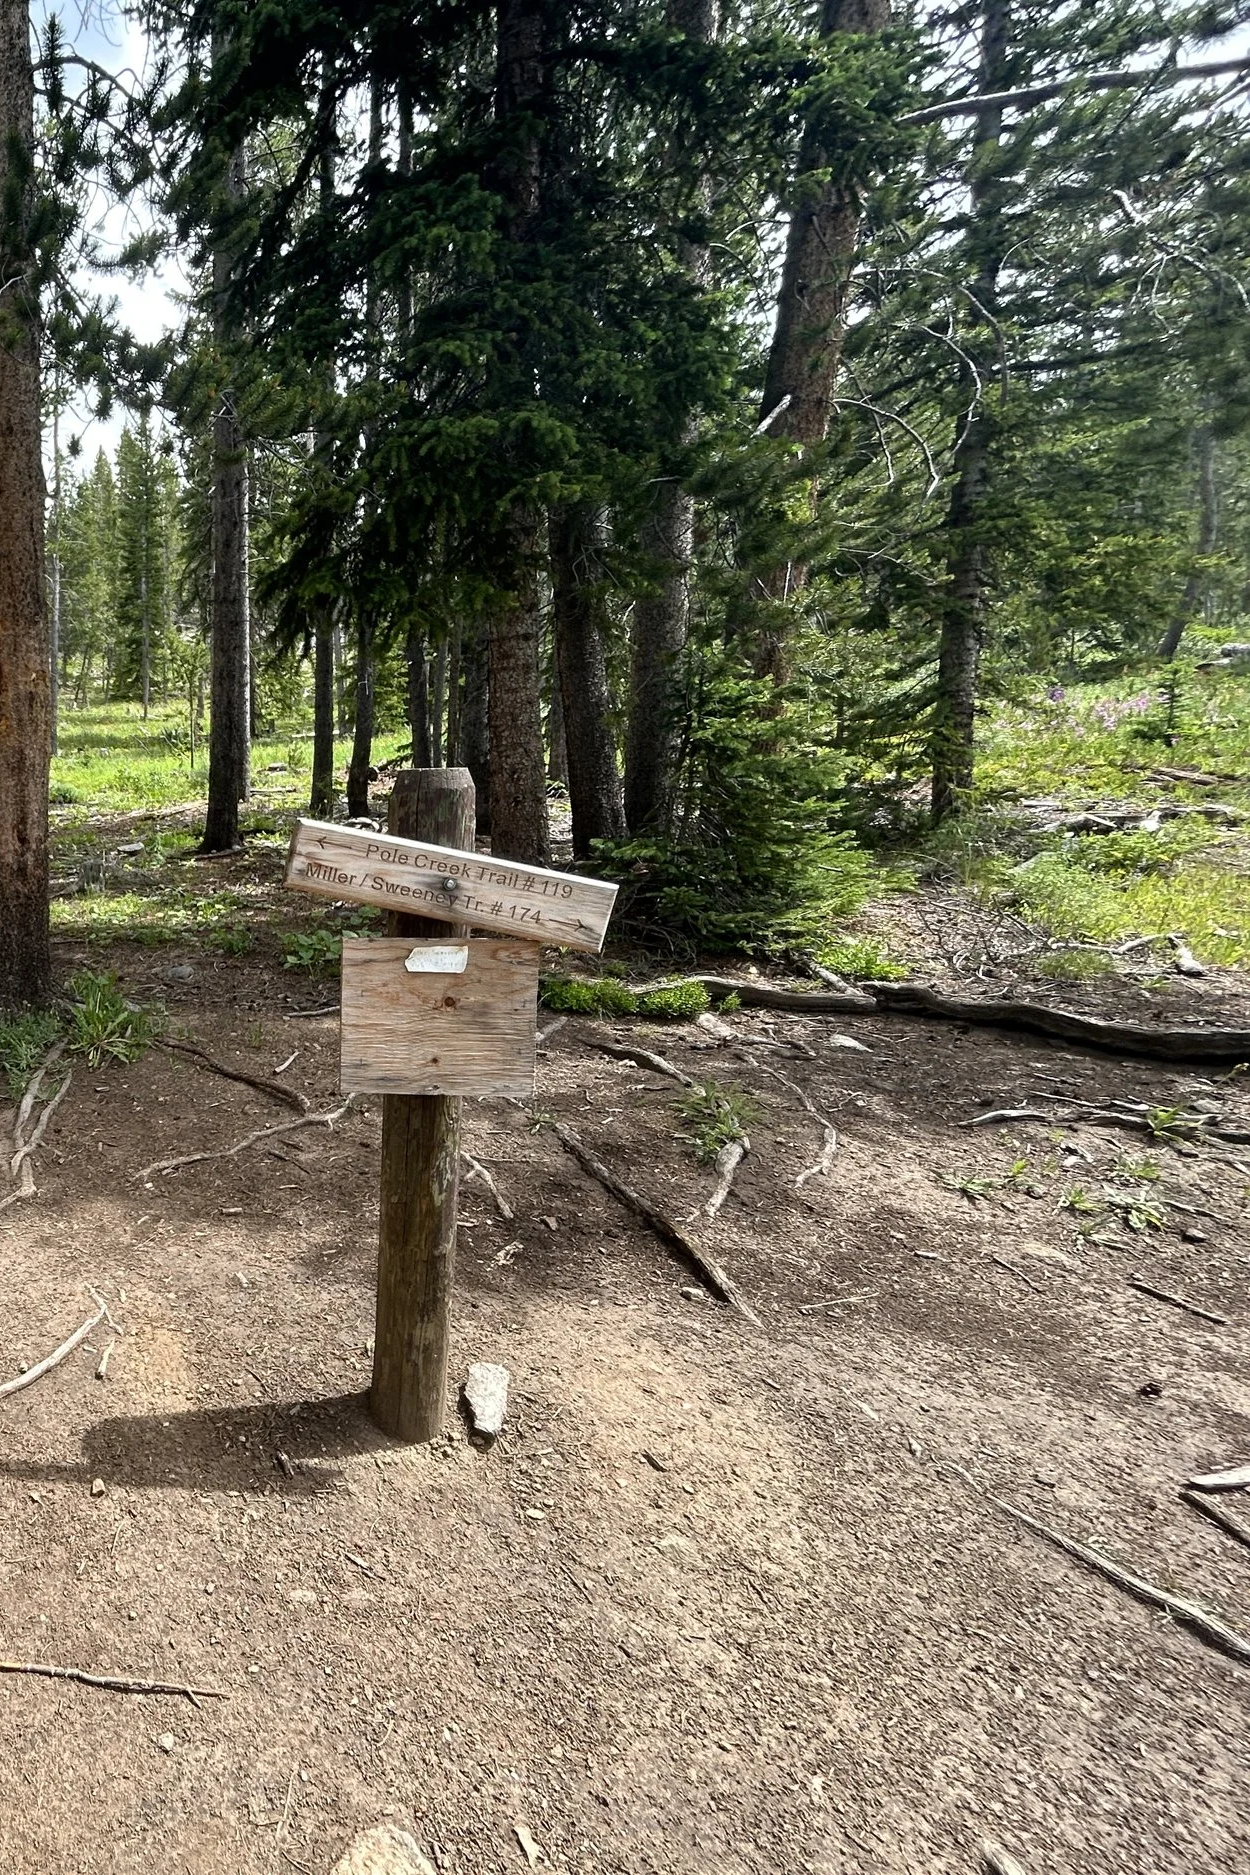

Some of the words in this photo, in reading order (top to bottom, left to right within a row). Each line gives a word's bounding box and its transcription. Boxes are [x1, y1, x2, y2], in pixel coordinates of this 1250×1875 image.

[305, 862, 357, 885] Miller
[370, 876, 458, 908] Sweeney
[464, 895, 484, 913] Tr.
[510, 905, 541, 924] 174
[366, 843, 409, 865] Pole
[414, 854, 471, 878] Creek
[477, 866, 519, 888] Trail
[541, 880, 573, 899] 119
